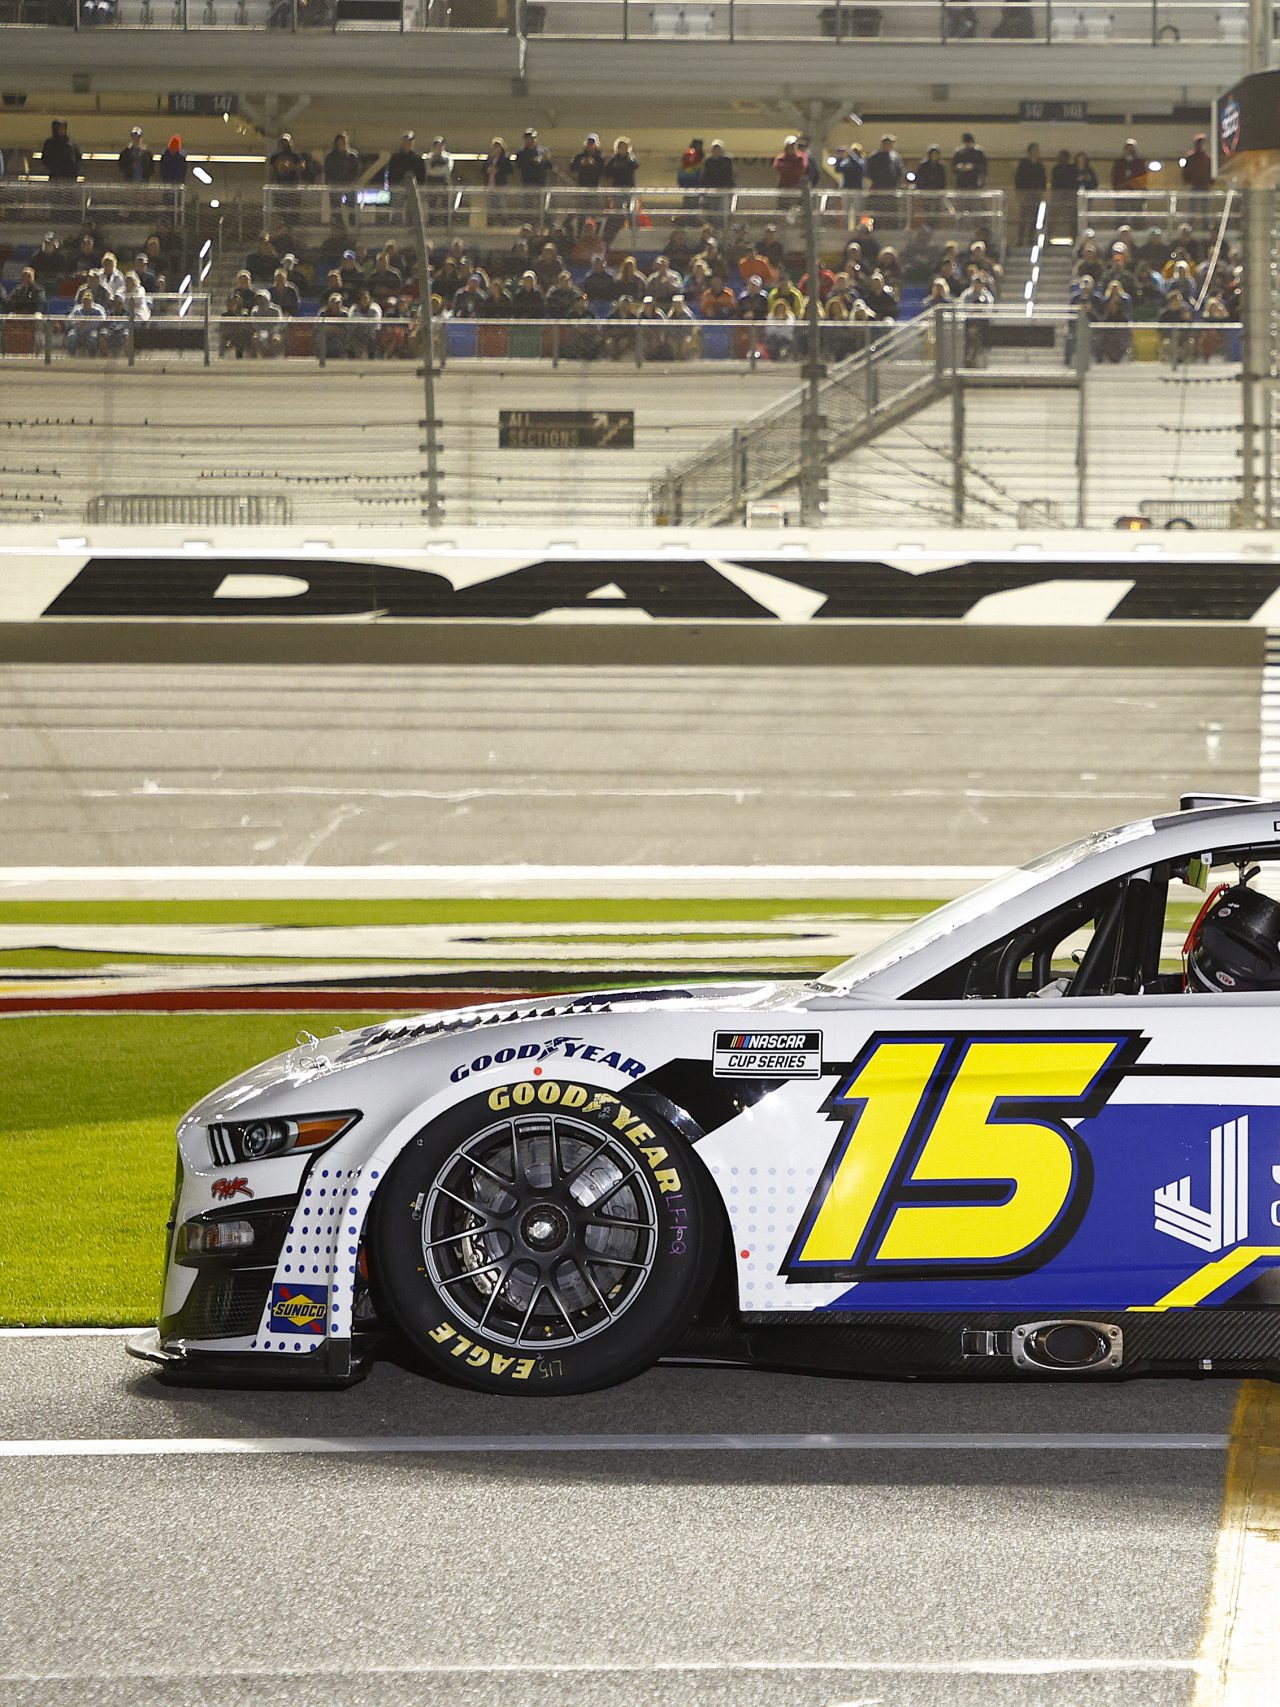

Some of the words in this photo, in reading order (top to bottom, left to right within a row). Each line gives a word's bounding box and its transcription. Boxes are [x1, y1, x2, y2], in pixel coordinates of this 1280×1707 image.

[748, 1035, 806, 1048] NASCAR
[728, 1055, 757, 1067] CUP
[758, 1055, 806, 1068] SERIES
[788, 1037, 1130, 1270] 15
[274, 1302, 327, 1318] SUNOCO
[428, 1321, 536, 1380] EAGLE
